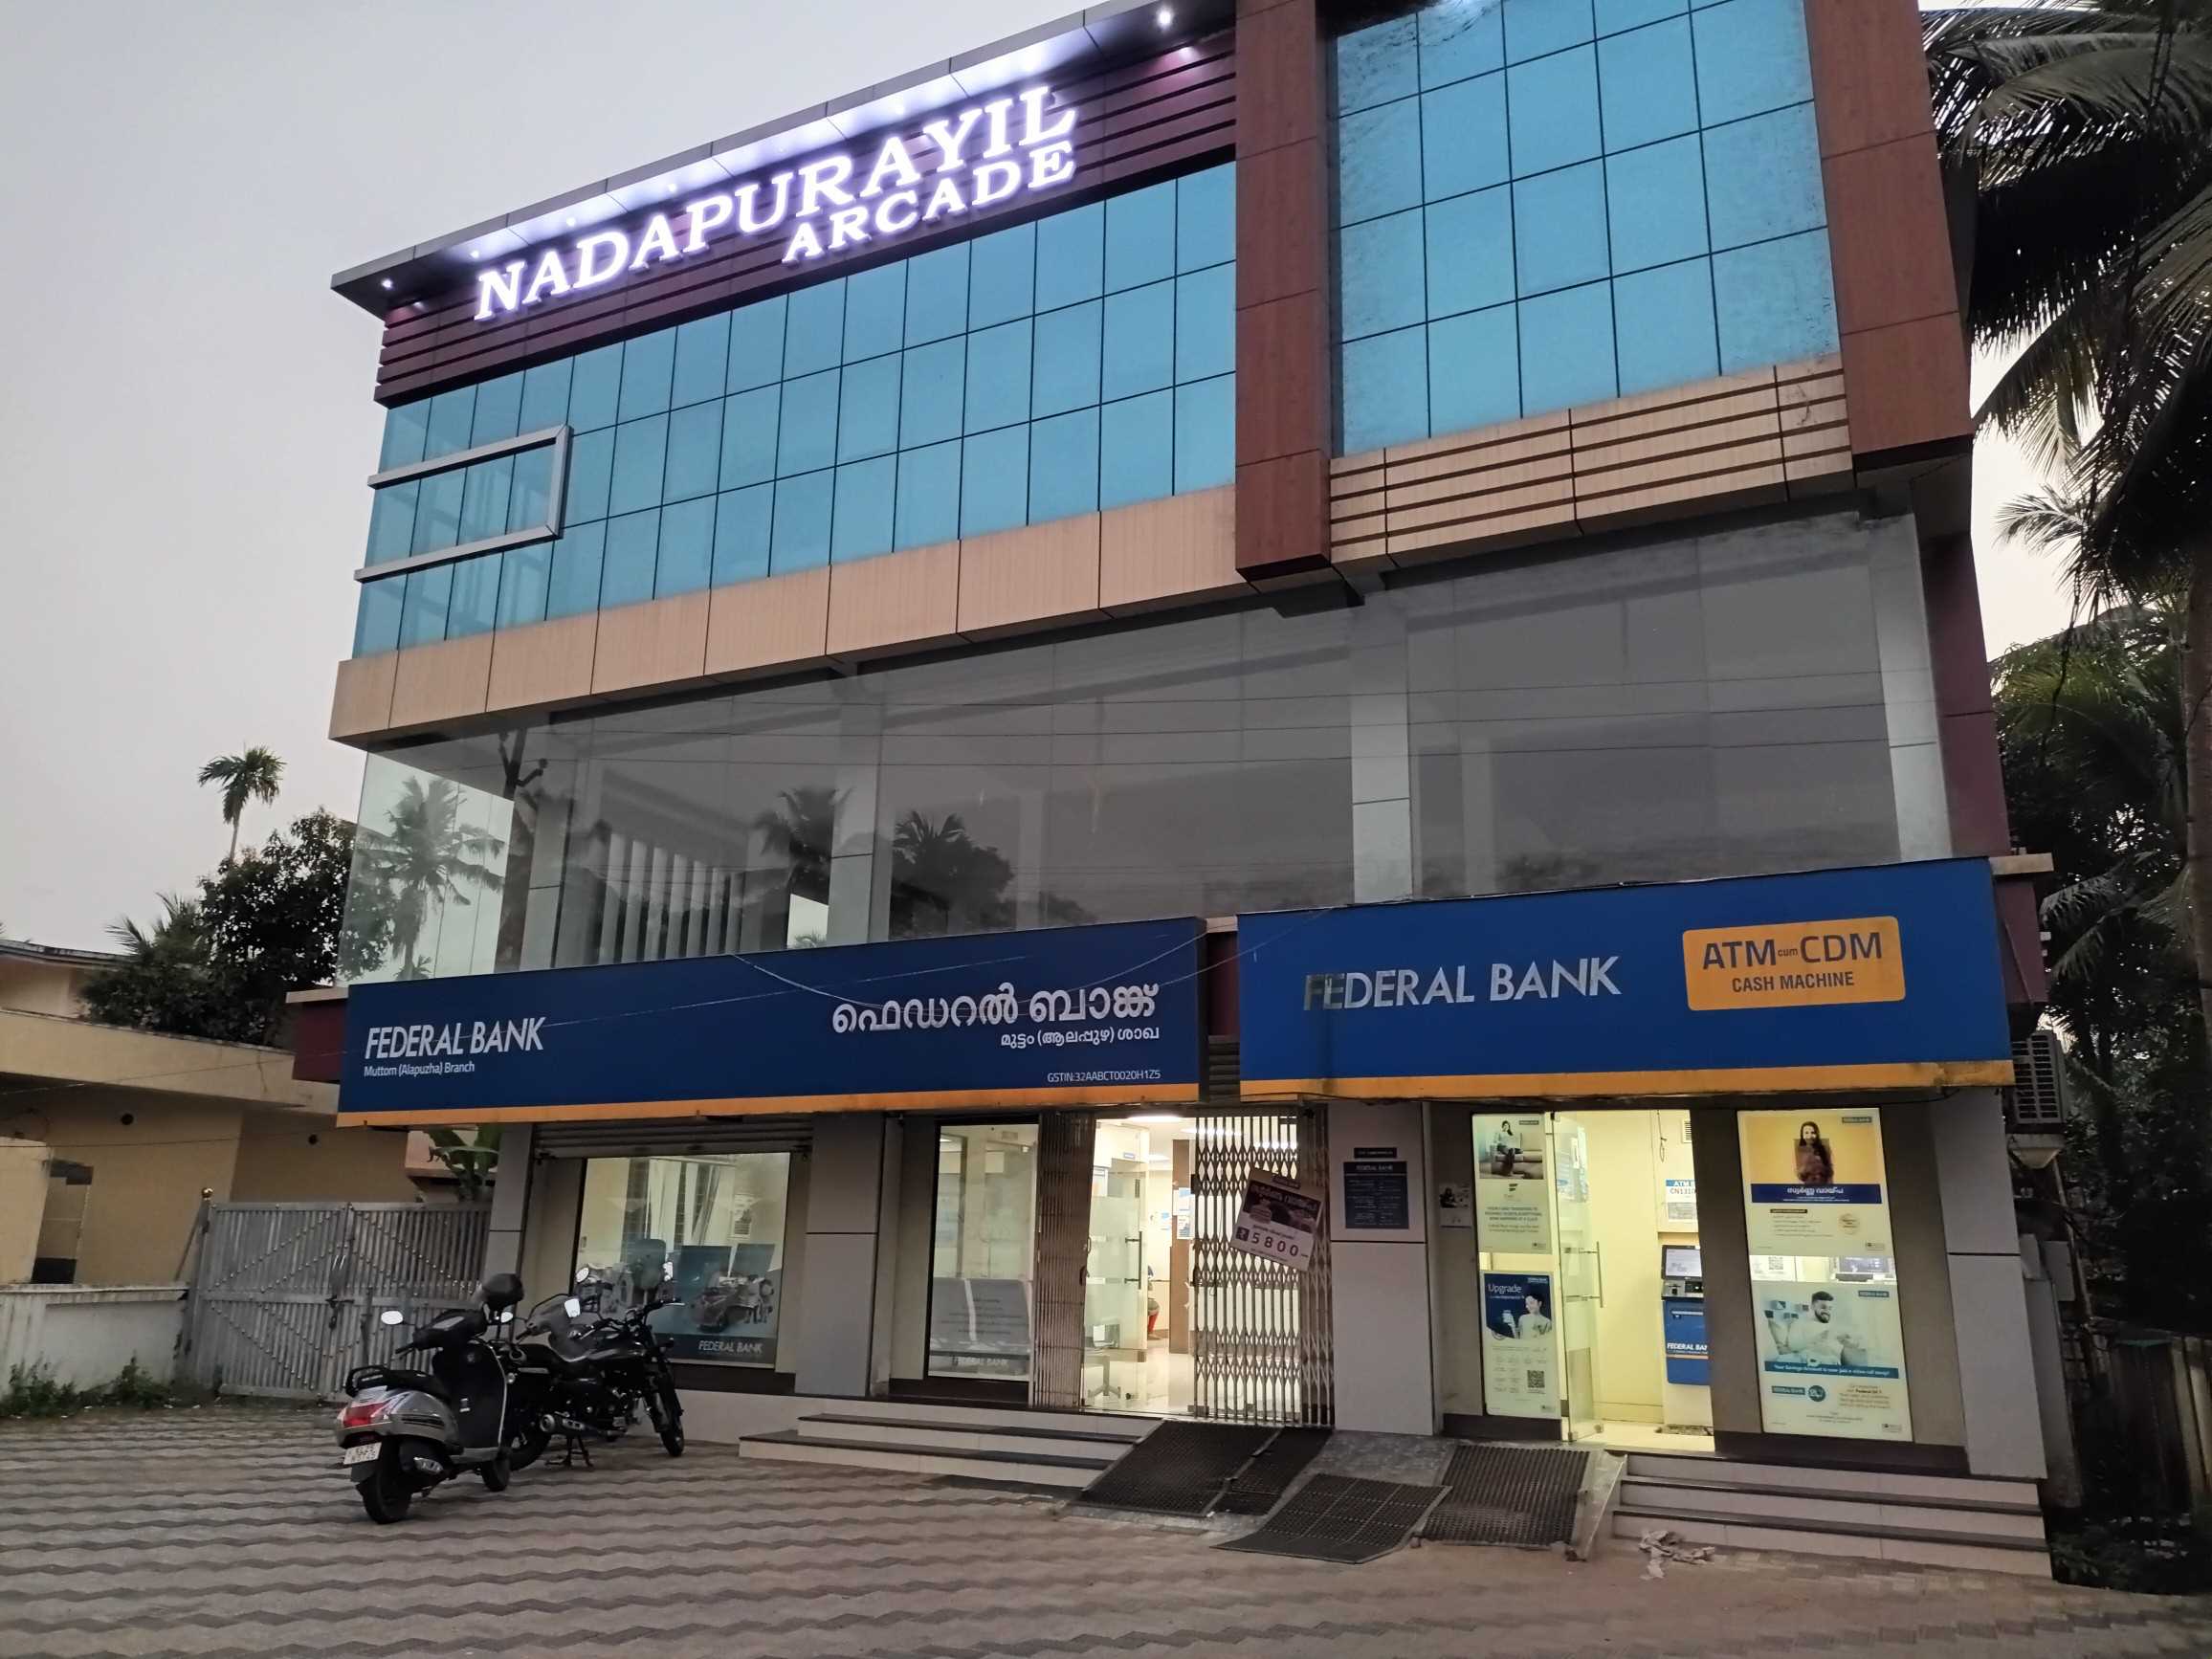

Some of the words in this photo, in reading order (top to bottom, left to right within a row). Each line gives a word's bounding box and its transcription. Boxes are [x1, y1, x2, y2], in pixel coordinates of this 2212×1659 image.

[474, 85, 1076, 321] NADAPURAYIL
[781, 141, 1076, 264] ARCADE
[1703, 939, 1777, 969] ATM
[1778, 947, 1799, 958] cum
[1801, 932, 1883, 963] CDM
[1303, 964, 1474, 1011] FEDERAL
[1490, 956, 1622, 1002] BANK
[1732, 975, 1775, 992] CASH
[1780, 971, 1854, 989] MACHINE
[365, 1023, 463, 1059] FEDERAL
[470, 1017, 546, 1053] BANK
[1117, 1027, 1160, 1040] ശാഖ
[364, 1065, 396, 1077] Muttom
[398, 1062, 442, 1077] (Alapuzha)
[444, 1061, 476, 1073] Branch
[1488, 1283, 1521, 1294] Upgrade
[698, 1340, 734, 1352] FEDERAL
[737, 1341, 763, 1354] BANK
